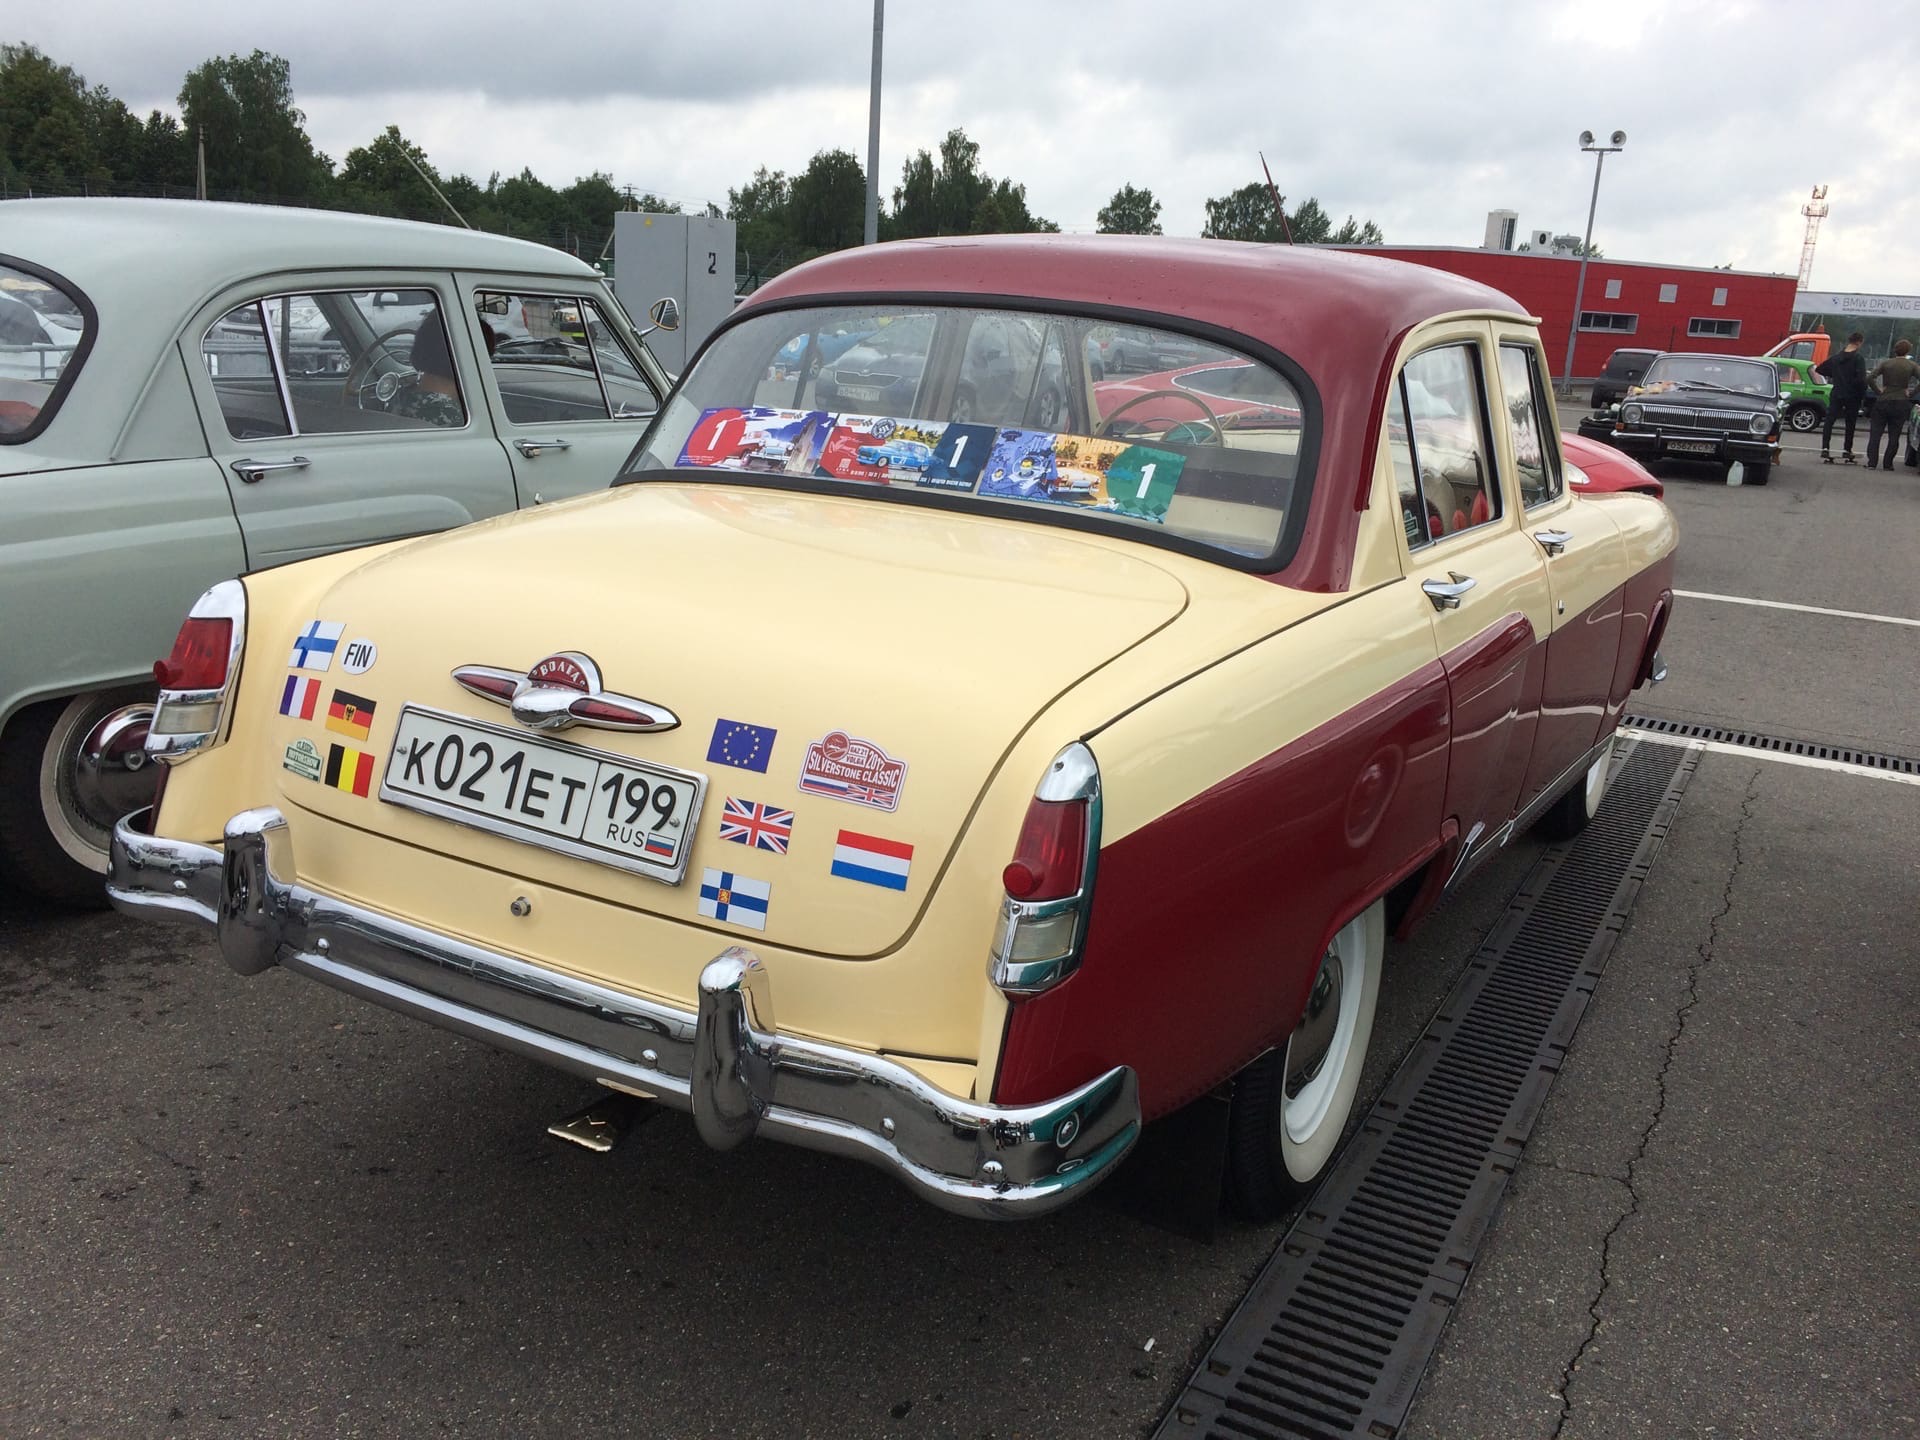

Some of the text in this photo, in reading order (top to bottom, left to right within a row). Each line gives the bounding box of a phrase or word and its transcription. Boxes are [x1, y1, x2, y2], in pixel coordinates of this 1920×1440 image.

[708, 252, 717, 275] 2
[1842, 297, 1867, 308] BMW
[1869, 299, 1911, 311] DRIVING
[707, 420, 728, 451] 1
[949, 435, 969, 469] 1
[1136, 463, 1157, 499] 1
[343, 643, 373, 668] FIN
[808, 750, 862, 780] SILVERSTONE
[862, 769, 900, 788] CLASSIC
[866, 750, 886, 771] 2017
[601, 772, 677, 831] 199
[606, 823, 645, 848] RUS
